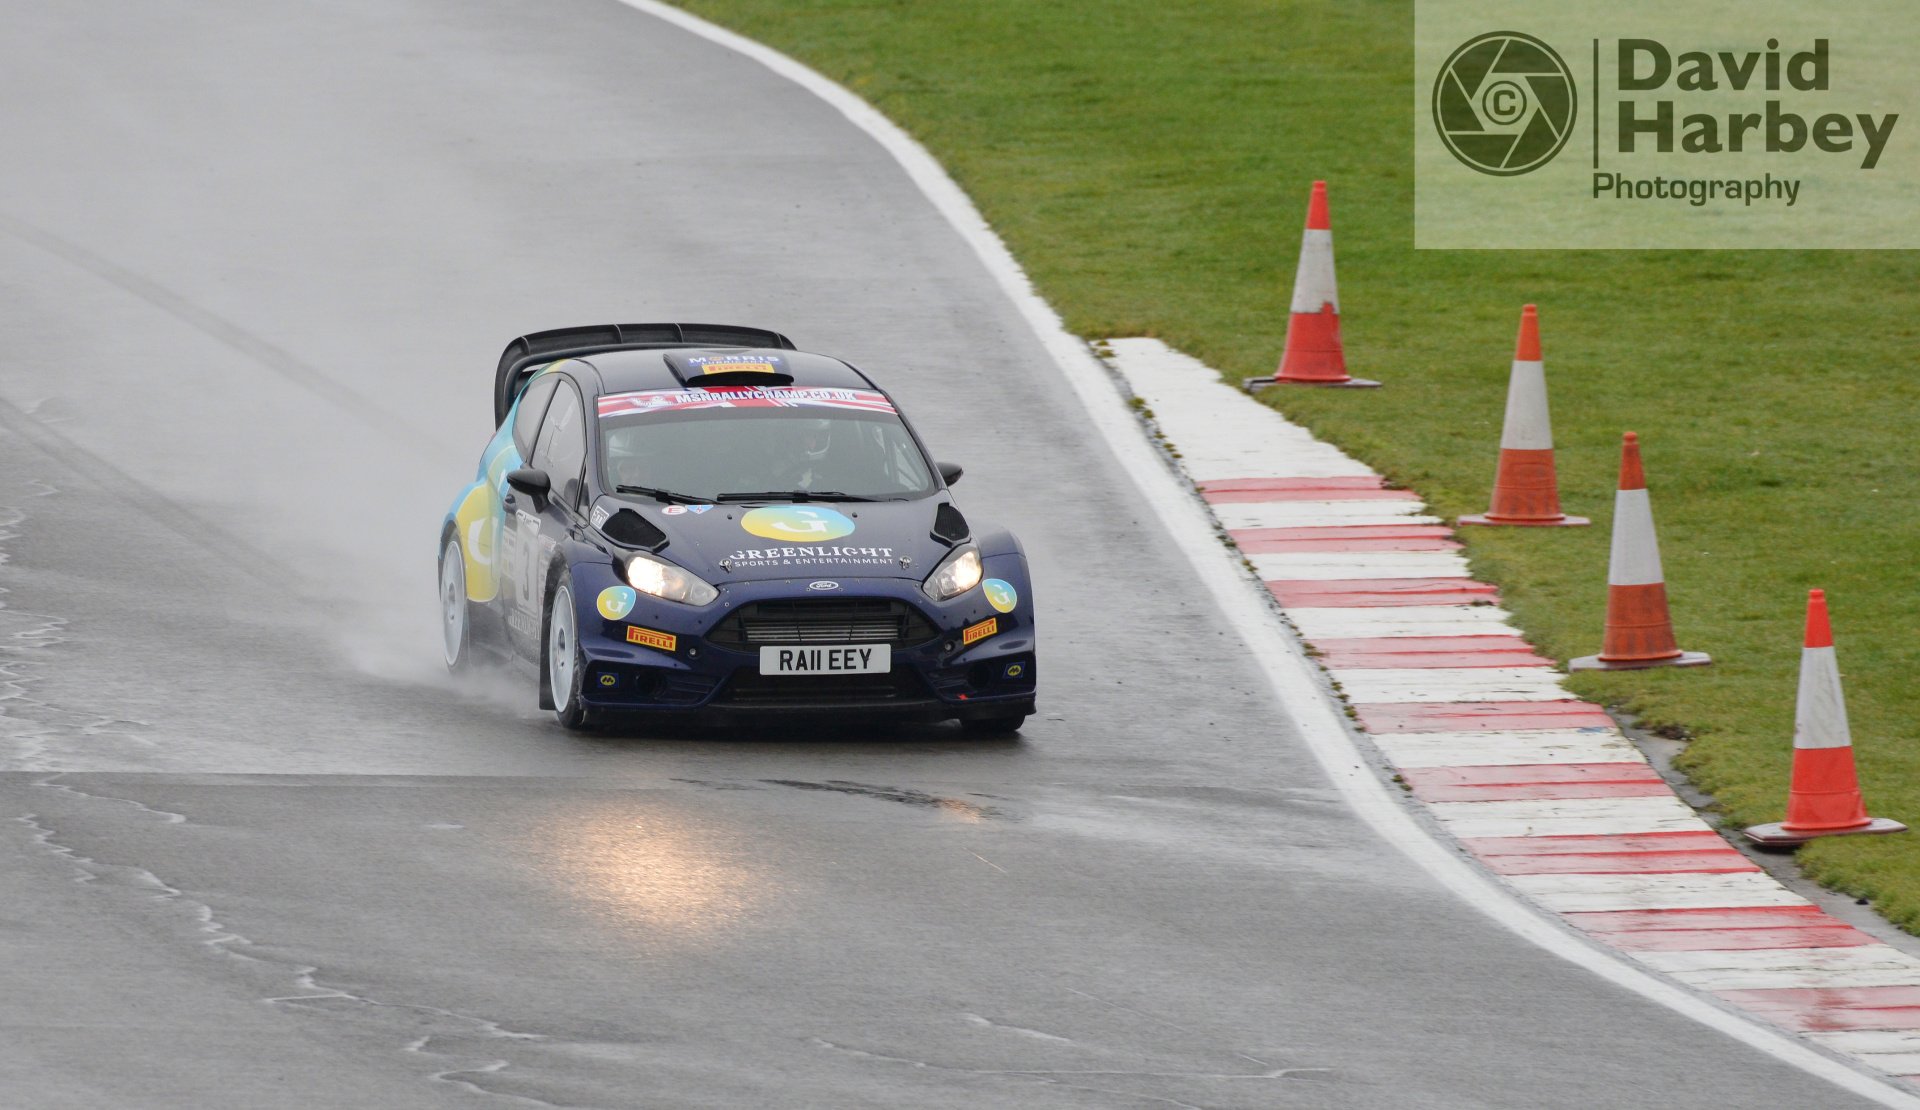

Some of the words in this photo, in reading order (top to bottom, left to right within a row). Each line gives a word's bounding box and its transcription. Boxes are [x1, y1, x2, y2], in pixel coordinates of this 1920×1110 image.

[675, 390, 857, 403] MSNRALLYCHAMP.CO.UK
[729, 547, 893, 560] GREENLIGHT
[735, 559, 778, 567] SPORTS
[795, 557, 894, 565] ENTERTAINMENT
[628, 627, 674, 649] PIRELLI
[965, 619, 995, 642] PIRELLI
[828, 648, 872, 670] EEY
